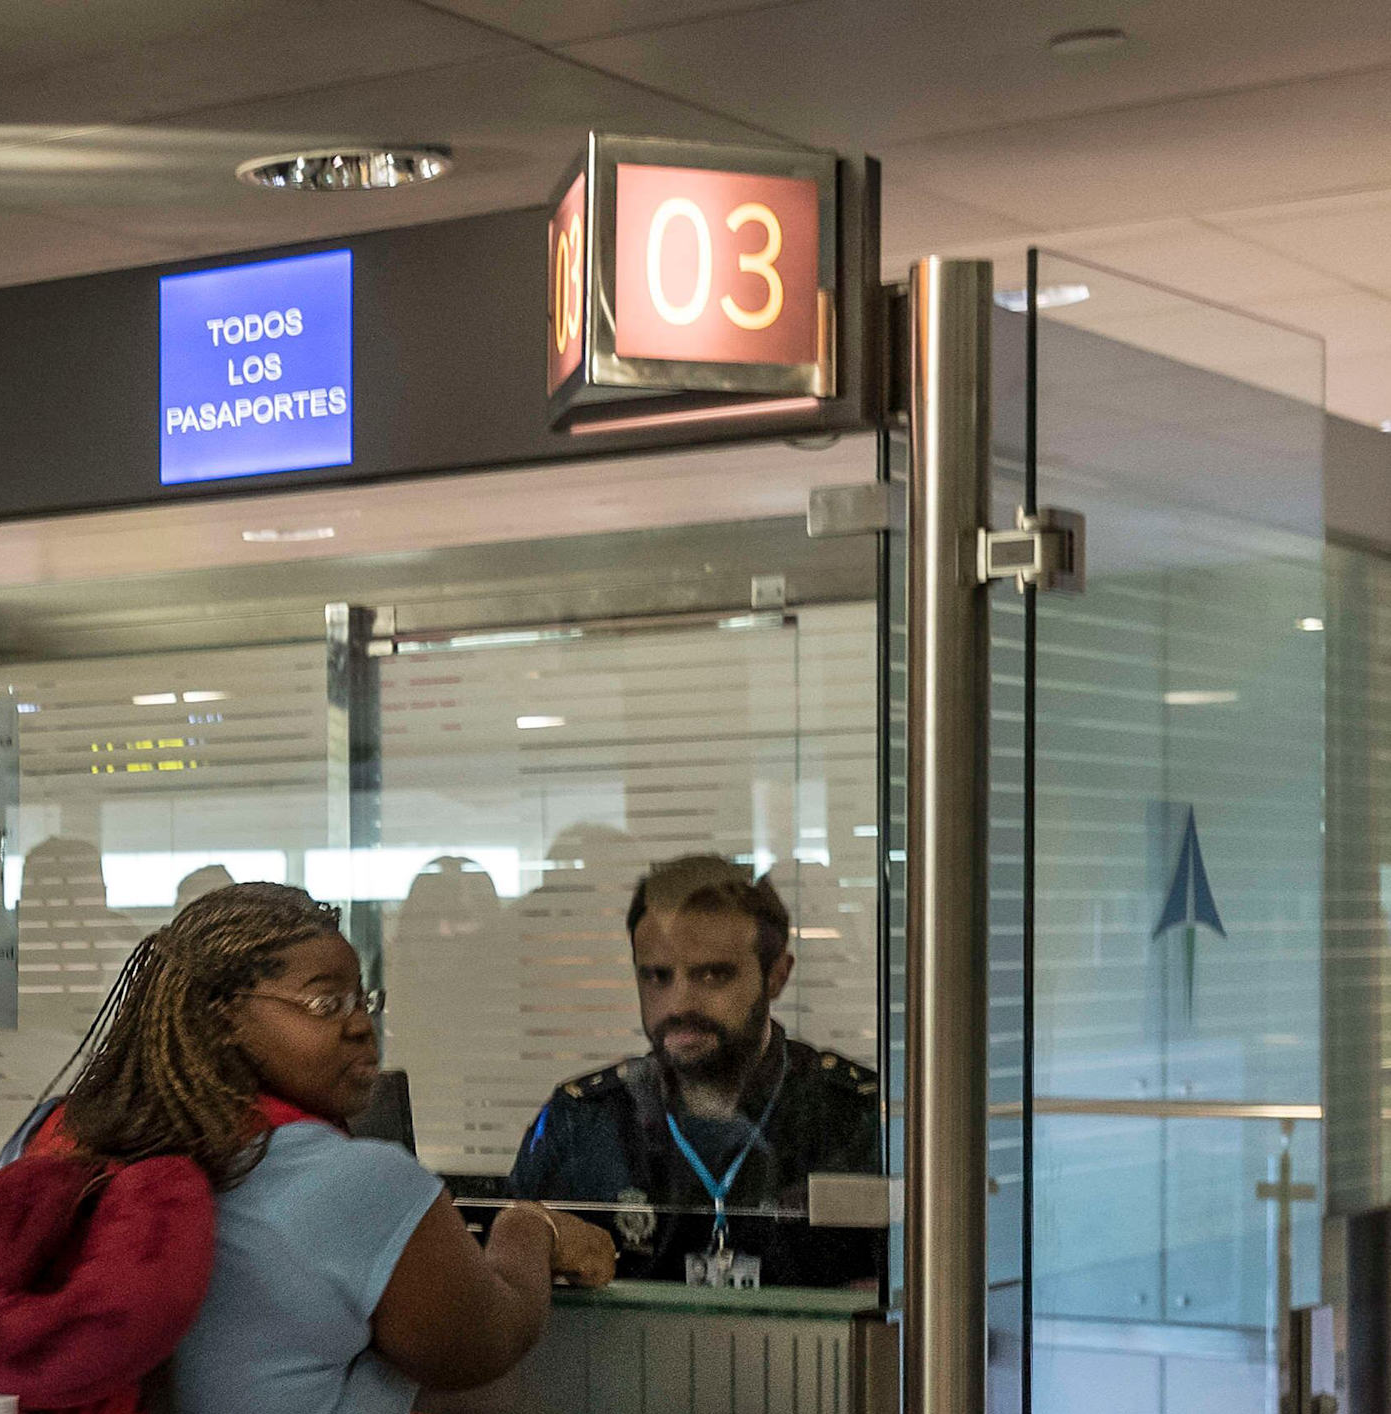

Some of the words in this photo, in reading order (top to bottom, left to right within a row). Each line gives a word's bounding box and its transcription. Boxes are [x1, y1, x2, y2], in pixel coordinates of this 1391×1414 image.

[555, 212, 583, 355] 03
[646, 196, 784, 330] 03
[206, 307, 304, 347] TODOS
[228, 352, 282, 386] LOS
[166, 386, 347, 435] PASAPORTES
